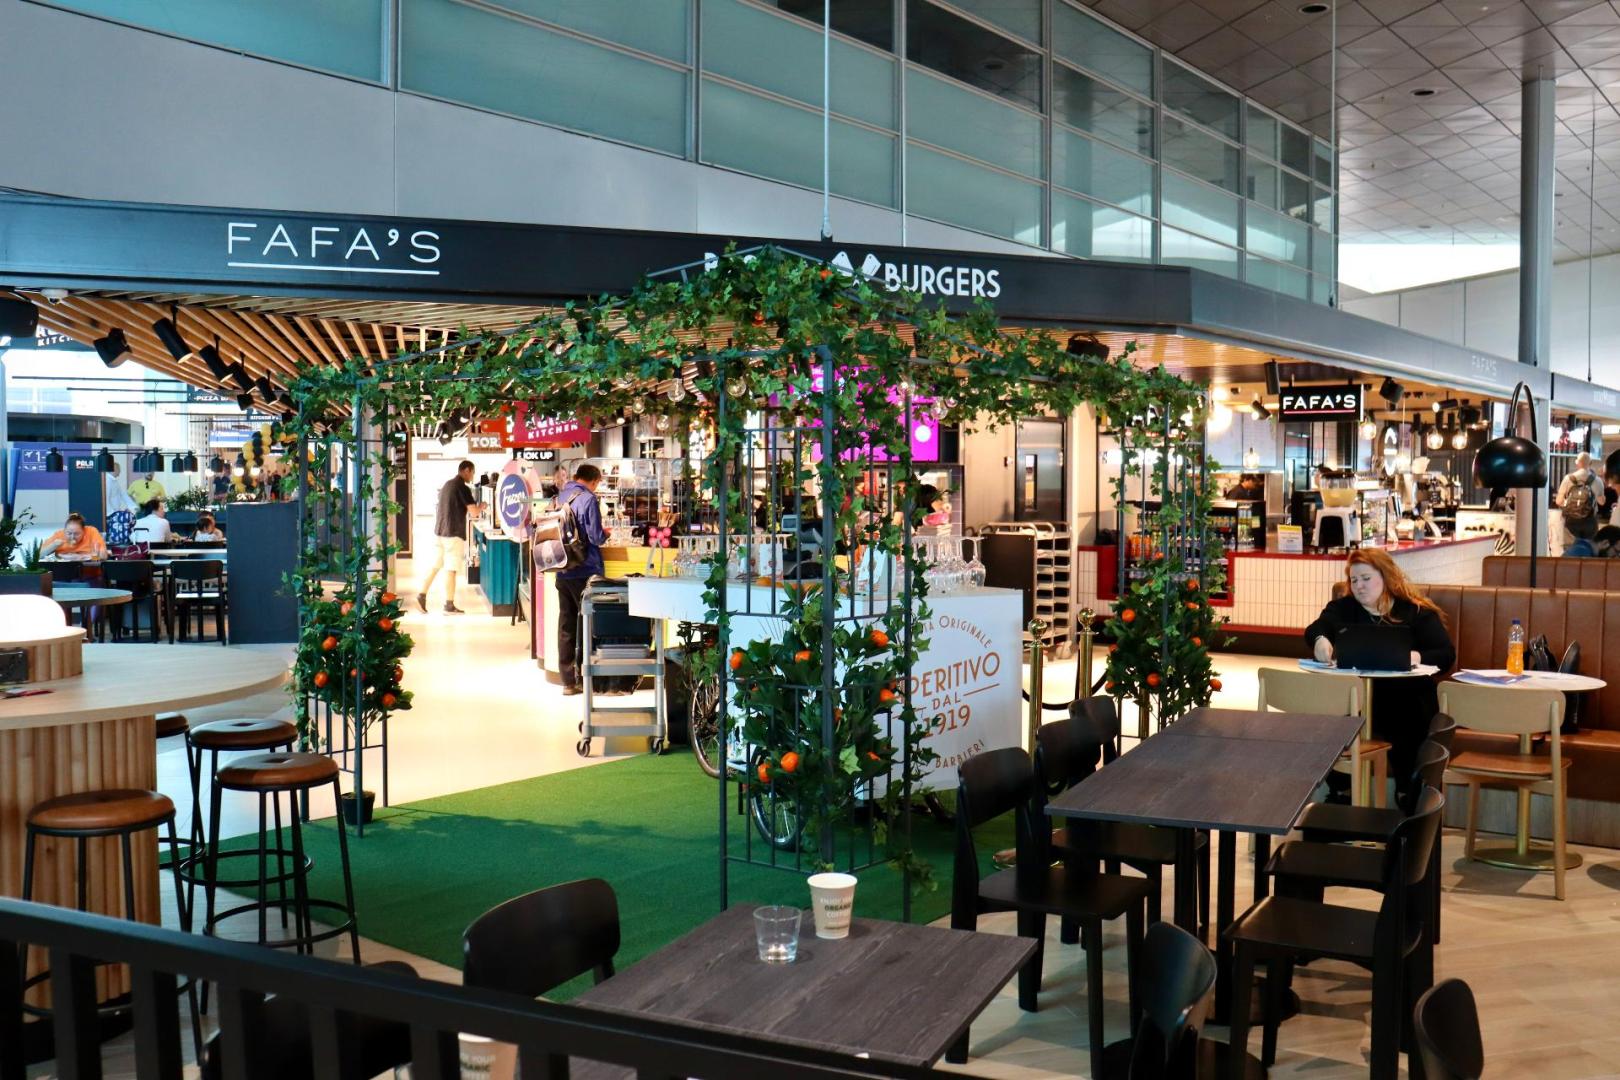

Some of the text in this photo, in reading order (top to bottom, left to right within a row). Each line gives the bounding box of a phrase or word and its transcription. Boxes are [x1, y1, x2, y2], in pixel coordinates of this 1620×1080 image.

[228, 222, 440, 263] FAFA'S
[884, 263, 1001, 298] BURGERS
[1282, 394, 1356, 410] FAFA'S
[527, 424, 578, 440] KITCHEN
[540, 452, 553, 460] UP
[899, 652, 1000, 704] PERITIVO
[931, 692, 961, 711] DAL
[922, 704, 971, 739] 1919
